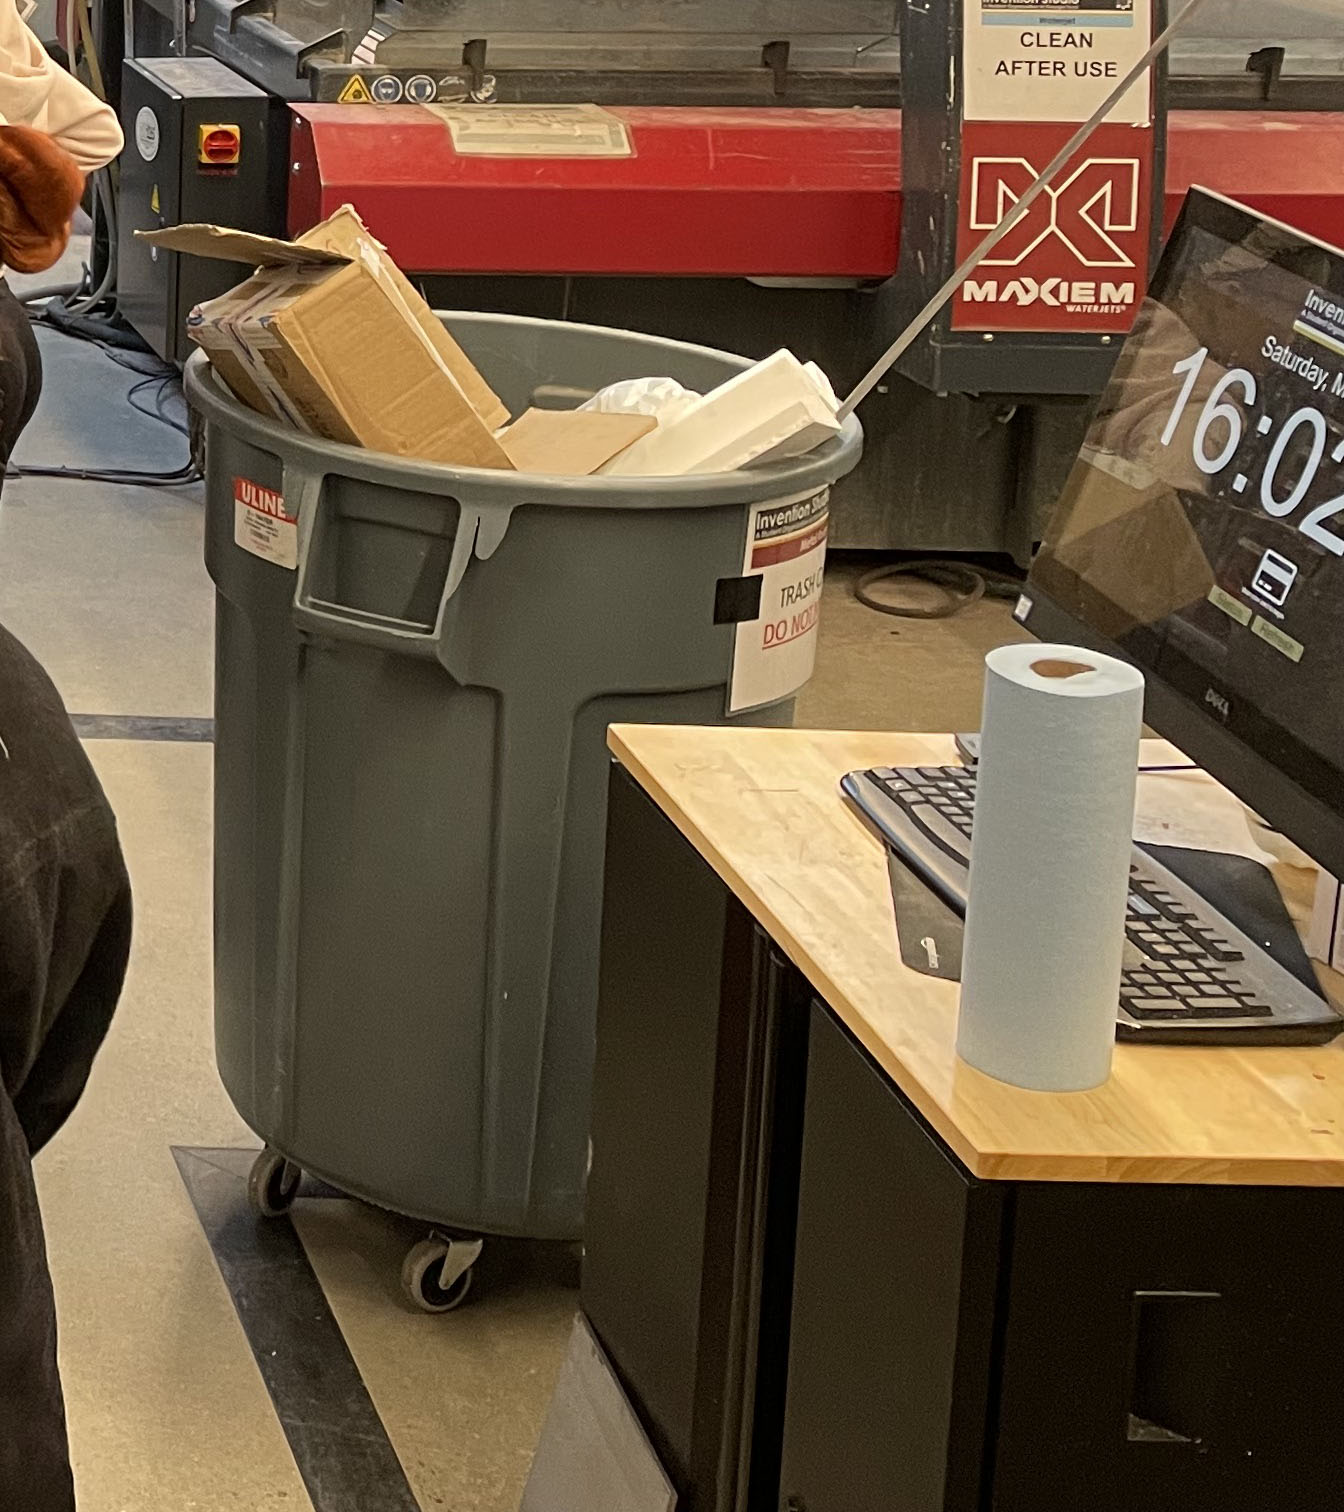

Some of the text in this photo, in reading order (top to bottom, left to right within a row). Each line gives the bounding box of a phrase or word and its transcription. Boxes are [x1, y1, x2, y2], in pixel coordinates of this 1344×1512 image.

[1019, 32, 1094, 48] CLEAN
[994, 60, 1119, 78] AFTER USE
[963, 277, 1135, 306] MAXIEM
[1261, 335, 1330, 392] Saturday,
[241, 481, 287, 519] ULINE
[757, 503, 810, 530] Invention
[781, 572, 815, 608] TRASH
[764, 620, 787, 645] DO
